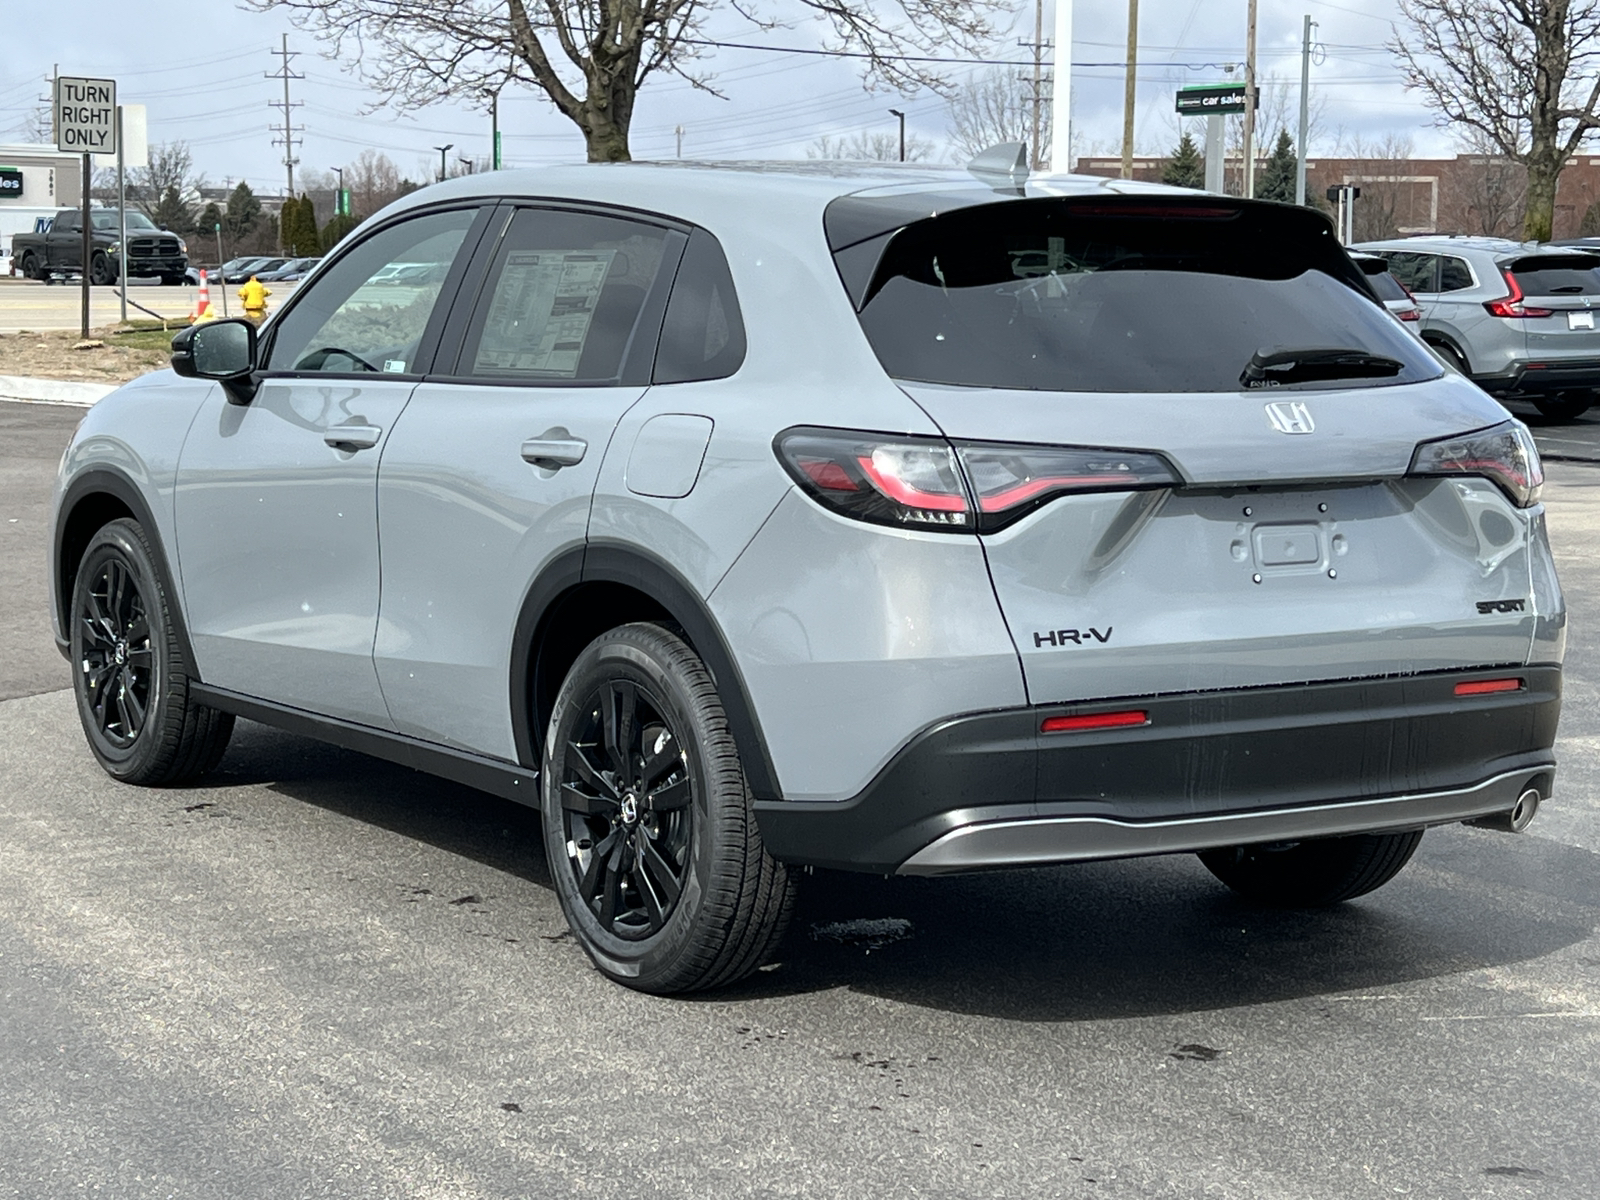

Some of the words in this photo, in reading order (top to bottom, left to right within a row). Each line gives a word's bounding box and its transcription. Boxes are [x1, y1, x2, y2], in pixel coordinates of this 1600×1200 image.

[64, 84, 109, 103] TURN
[1202, 97, 1219, 106] car
[62, 106, 111, 125] RIGHT
[65, 128, 108, 146] ONLY
[1475, 599, 1525, 614] SPORT
[1033, 626, 1113, 648] HR-V
